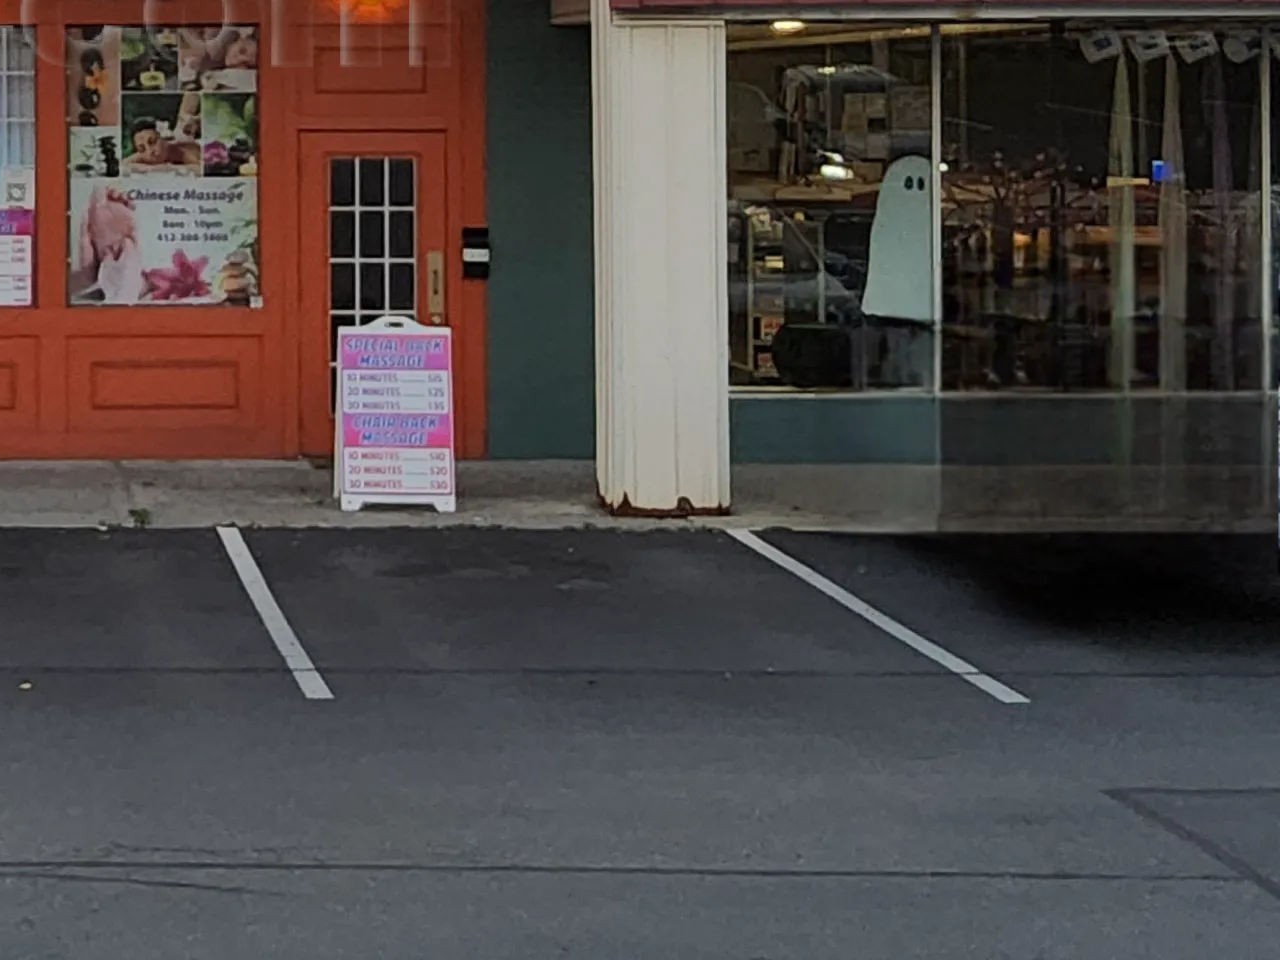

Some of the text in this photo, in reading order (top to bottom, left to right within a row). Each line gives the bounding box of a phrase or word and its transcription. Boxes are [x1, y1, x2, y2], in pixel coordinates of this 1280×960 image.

[127, 188, 244, 204] Chinese Massage
[347, 339, 398, 351] SPECIAL
[359, 355, 424, 367] MASSAGE
